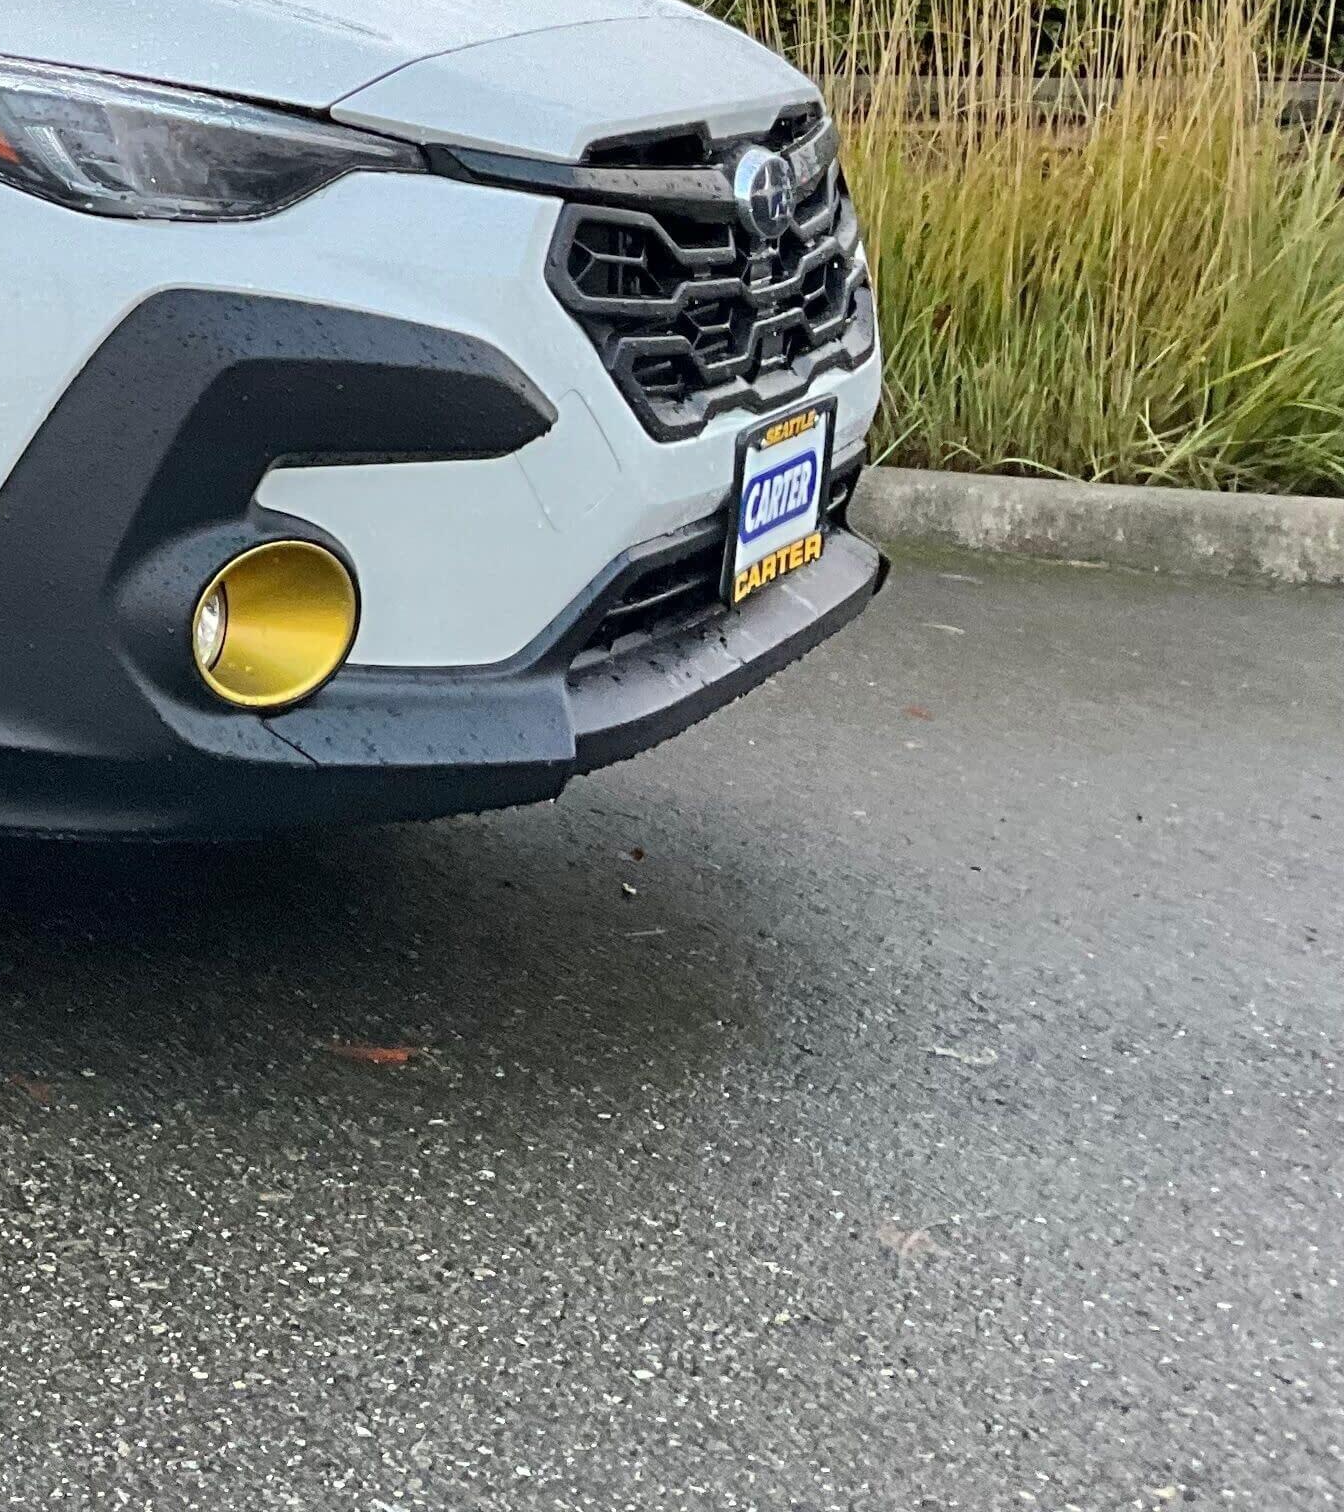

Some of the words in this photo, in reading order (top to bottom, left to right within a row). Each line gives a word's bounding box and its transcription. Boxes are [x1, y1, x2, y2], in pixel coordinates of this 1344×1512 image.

[765, 409, 816, 444] SEATTLE
[744, 459, 812, 534] CARTER
[734, 531, 822, 603] CARTER
